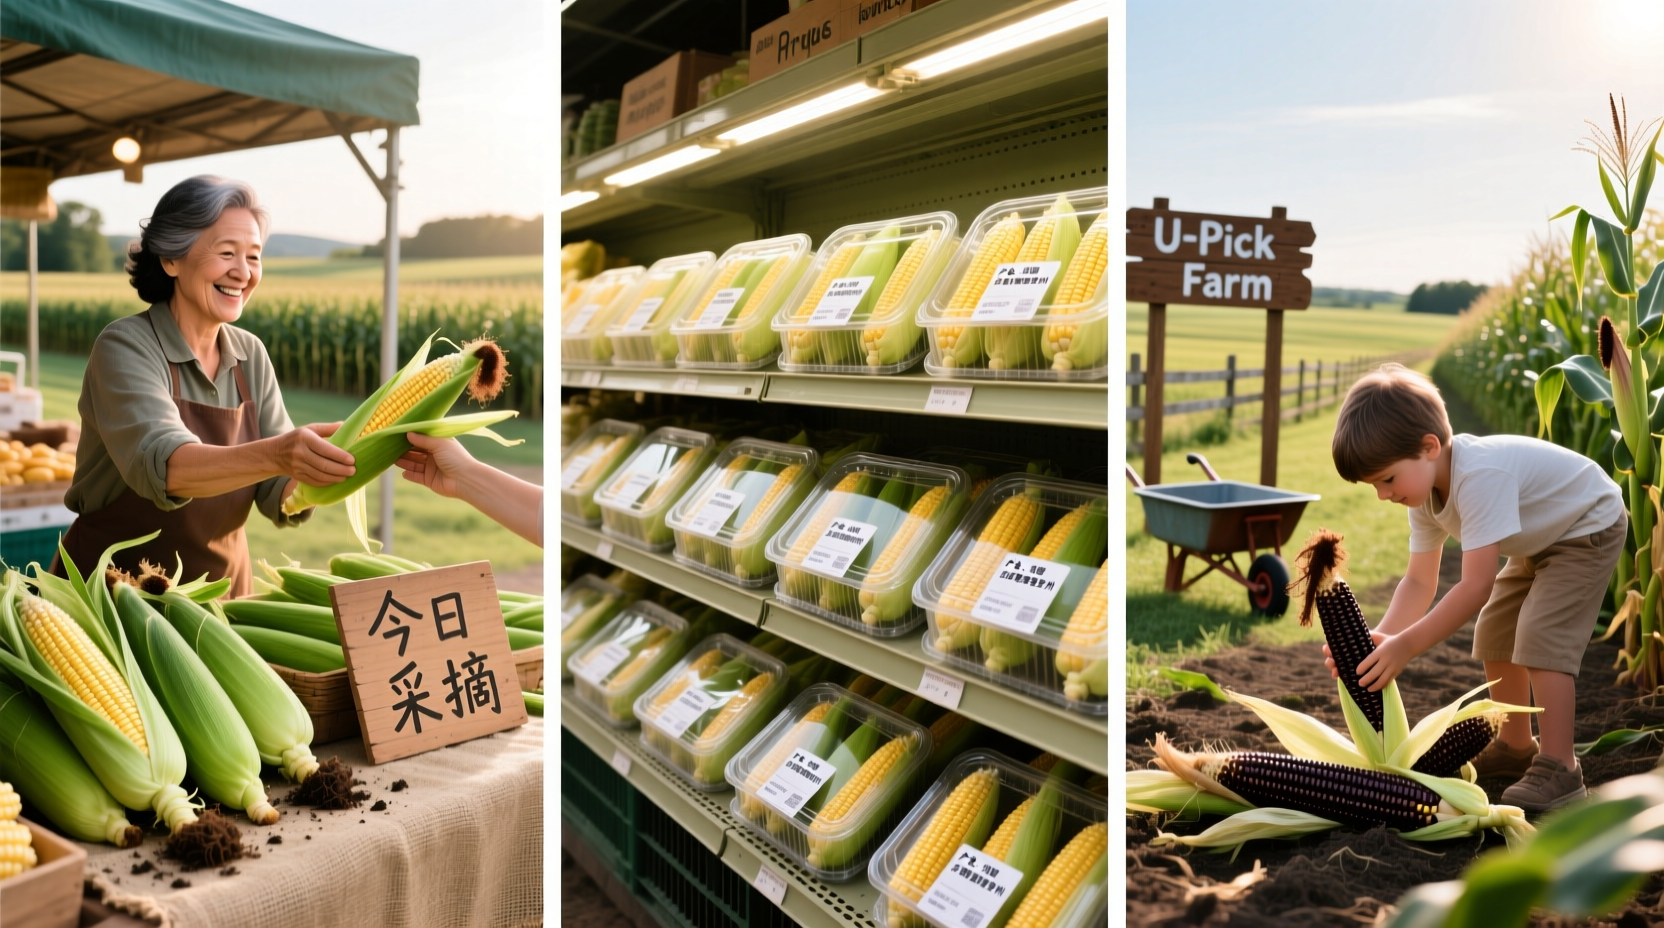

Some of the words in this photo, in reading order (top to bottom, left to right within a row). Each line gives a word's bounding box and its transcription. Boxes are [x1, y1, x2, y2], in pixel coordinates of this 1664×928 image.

[1154, 216, 1276, 260] U-Pick
[1183, 262, 1272, 301] Farm
[368, 590, 468, 657] 今日
[389, 651, 502, 734] 采摘
